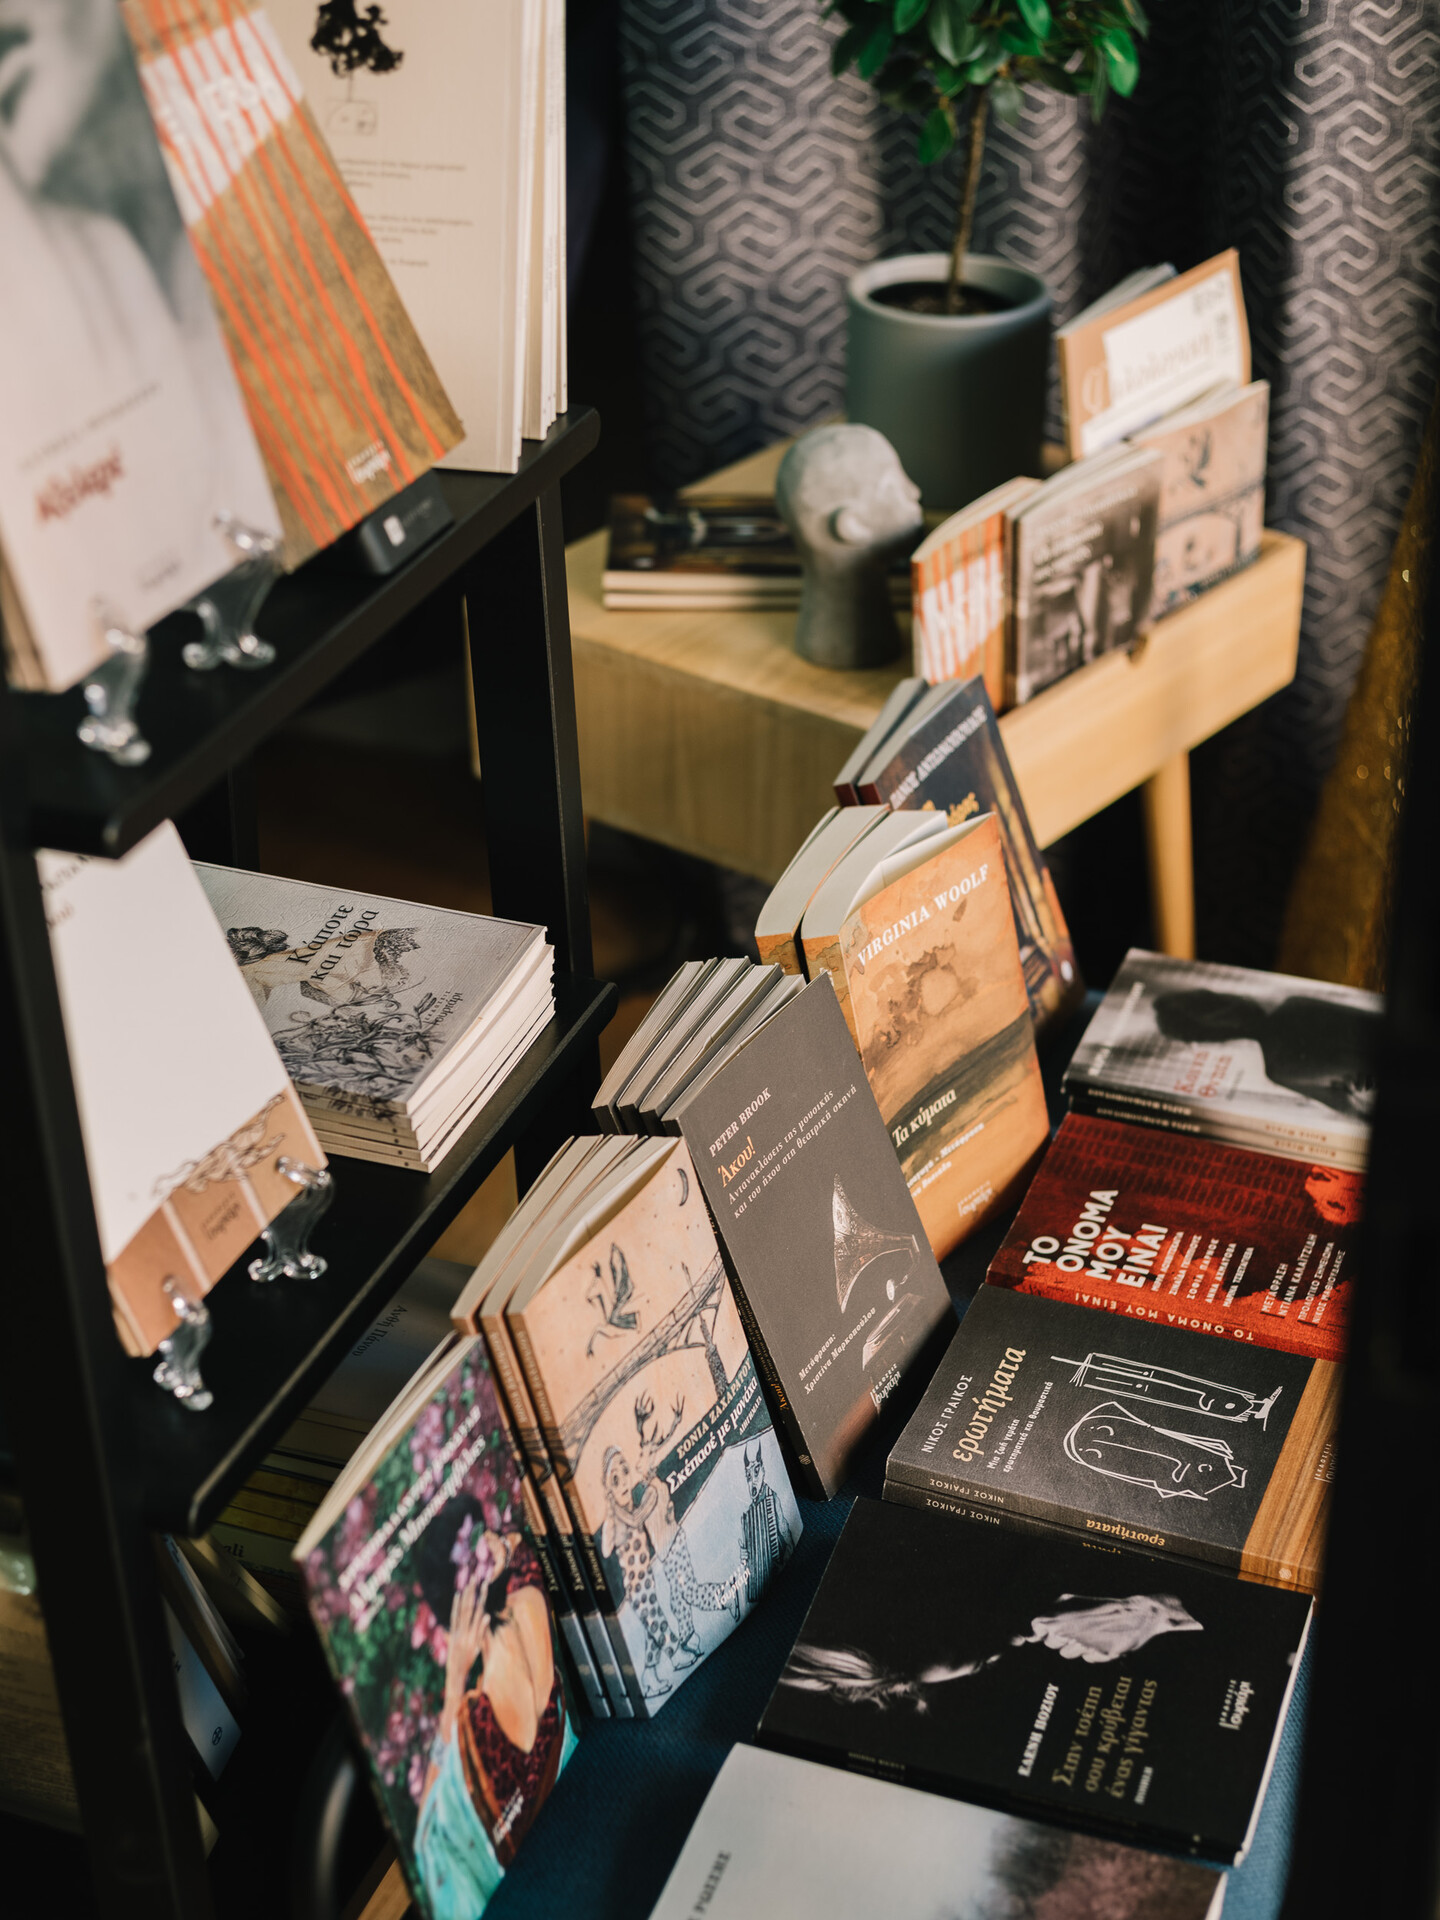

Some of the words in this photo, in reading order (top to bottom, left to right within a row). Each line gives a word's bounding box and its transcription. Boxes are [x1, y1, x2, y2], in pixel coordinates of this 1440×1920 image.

[285, 904, 354, 966] Κάποτε
[857, 905, 931, 967] VIRGINIA
[933, 863, 989, 911] WOOLF
[310, 954, 343, 982] και
[336, 910, 380, 949] τώρα
[708, 1121, 740, 1158] PETER
[738, 1087, 772, 1126] BROOK
[891, 1125, 910, 1148] Τα
[909, 1088, 957, 1134] κύματα
[717, 1136, 756, 1188] Άκου!
[728, 1142, 784, 1205] Αντανακλάσεις
[783, 1128, 798, 1144] της
[798, 1089, 834, 1133] μουσικής
[733, 1201, 748, 1219] και
[747, 1185, 762, 1203] του
[761, 1163, 782, 1188] ήχου
[782, 1148, 797, 1165] στη
[796, 1110, 832, 1149] θεατρική
[832, 1083, 858, 1113] σκηνή
[1022, 1235, 1060, 1264] ΤΟ
[1055, 1189, 1119, 1273] ΟΝΟΜΑ
[1085, 1225, 1132, 1281] ΜΟΥ
[1115, 1223, 1169, 1289] ΕΙΝΑΙ
[1075, 1292, 1117, 1310] ΕΙΝΑΙ
[1125, 1304, 1158, 1320] ΜΟΥ
[1205, 1278, 1220, 1304] ΑΝΝΑ
[1260, 1263, 1289, 1313] ΜΕΤΑΦΡΑΣΗ
[1277, 1285, 1298, 1317] ΝΤΙΑΝΑ
[377, 1304, 408, 1327] Ανθή
[1167, 1313, 1225, 1334] ΟΝΟΜΑ
[1233, 1329, 1254, 1341] ΤΟ
[351, 1328, 388, 1357] Πάνου
[798, 1333, 837, 1381] Μετάφραση:
[804, 1359, 833, 1395] Χριστίνα
[830, 1306, 876, 1361] Μαρκοπούλου
[676, 1422, 710, 1461] ΣΟΝΙΑ
[708, 1357, 752, 1425] ΖΑΧΑΡΑΤΟΥ
[921, 1421, 948, 1454] ΝΙΚΟΣ
[941, 1374, 973, 1419] ΓΡΑΙΚΟΣ
[952, 1347, 1027, 1462] ερωτήματα
[1024, 1420, 1035, 1432] και
[1028, 1381, 1054, 1419] θαυμαστικά
[665, 1431, 718, 1495] Σκέπασέ
[716, 1417, 732, 1447] με
[730, 1376, 758, 1430] μονάχα
[986, 1455, 1000, 1470] Μια
[994, 1441, 1008, 1455] ζωή
[1004, 1418, 1021, 1442] γεμάτη
[1003, 1432, 1029, 1473] ερωτηματικά
[926, 1498, 966, 1515] ΓΡΑΙΚΟΣ
[929, 1478, 970, 1495] ΓΡΑΙΚΟΣ
[974, 1490, 1004, 1504] ΝΙΚΟΣ
[970, 1511, 1000, 1525] ΝΙΚΟΣ
[1086, 1519, 1166, 1547] ερωτήματα
[1018, 1731, 1043, 1777] ΕΛΕΝΗ
[1034, 1682, 1060, 1731] ΠΟΖΙΟΥ
[1052, 1740, 1084, 1787] Στην
[1075, 1685, 1103, 1737] τσέπη
[1085, 1757, 1106, 1793] σου
[1097, 1675, 1133, 1754] κρύβεται
[1105, 1757, 1134, 1799] ένας
[1124, 1679, 1158, 1754] γίγαντας
